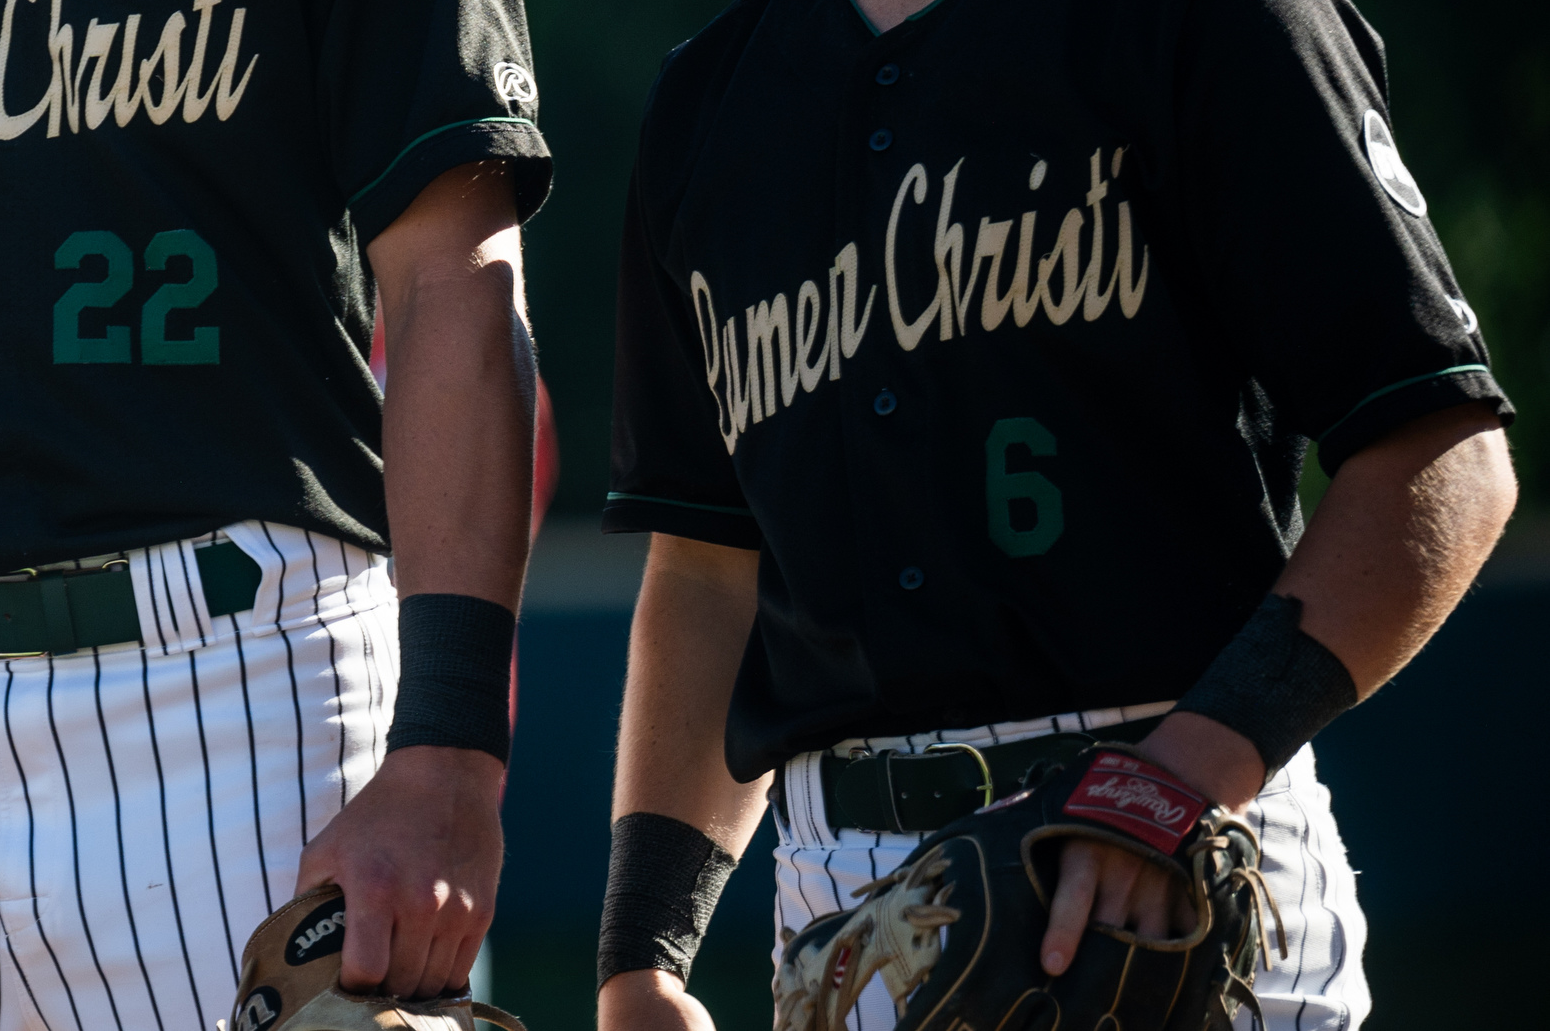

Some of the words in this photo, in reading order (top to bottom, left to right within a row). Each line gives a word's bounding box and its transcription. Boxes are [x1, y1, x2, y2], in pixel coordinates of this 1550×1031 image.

[53, 229, 220, 364] 22
[885, 147, 1148, 351] Christi
[986, 417, 1064, 558] 6
[1087, 777, 1186, 824] Rawlings
